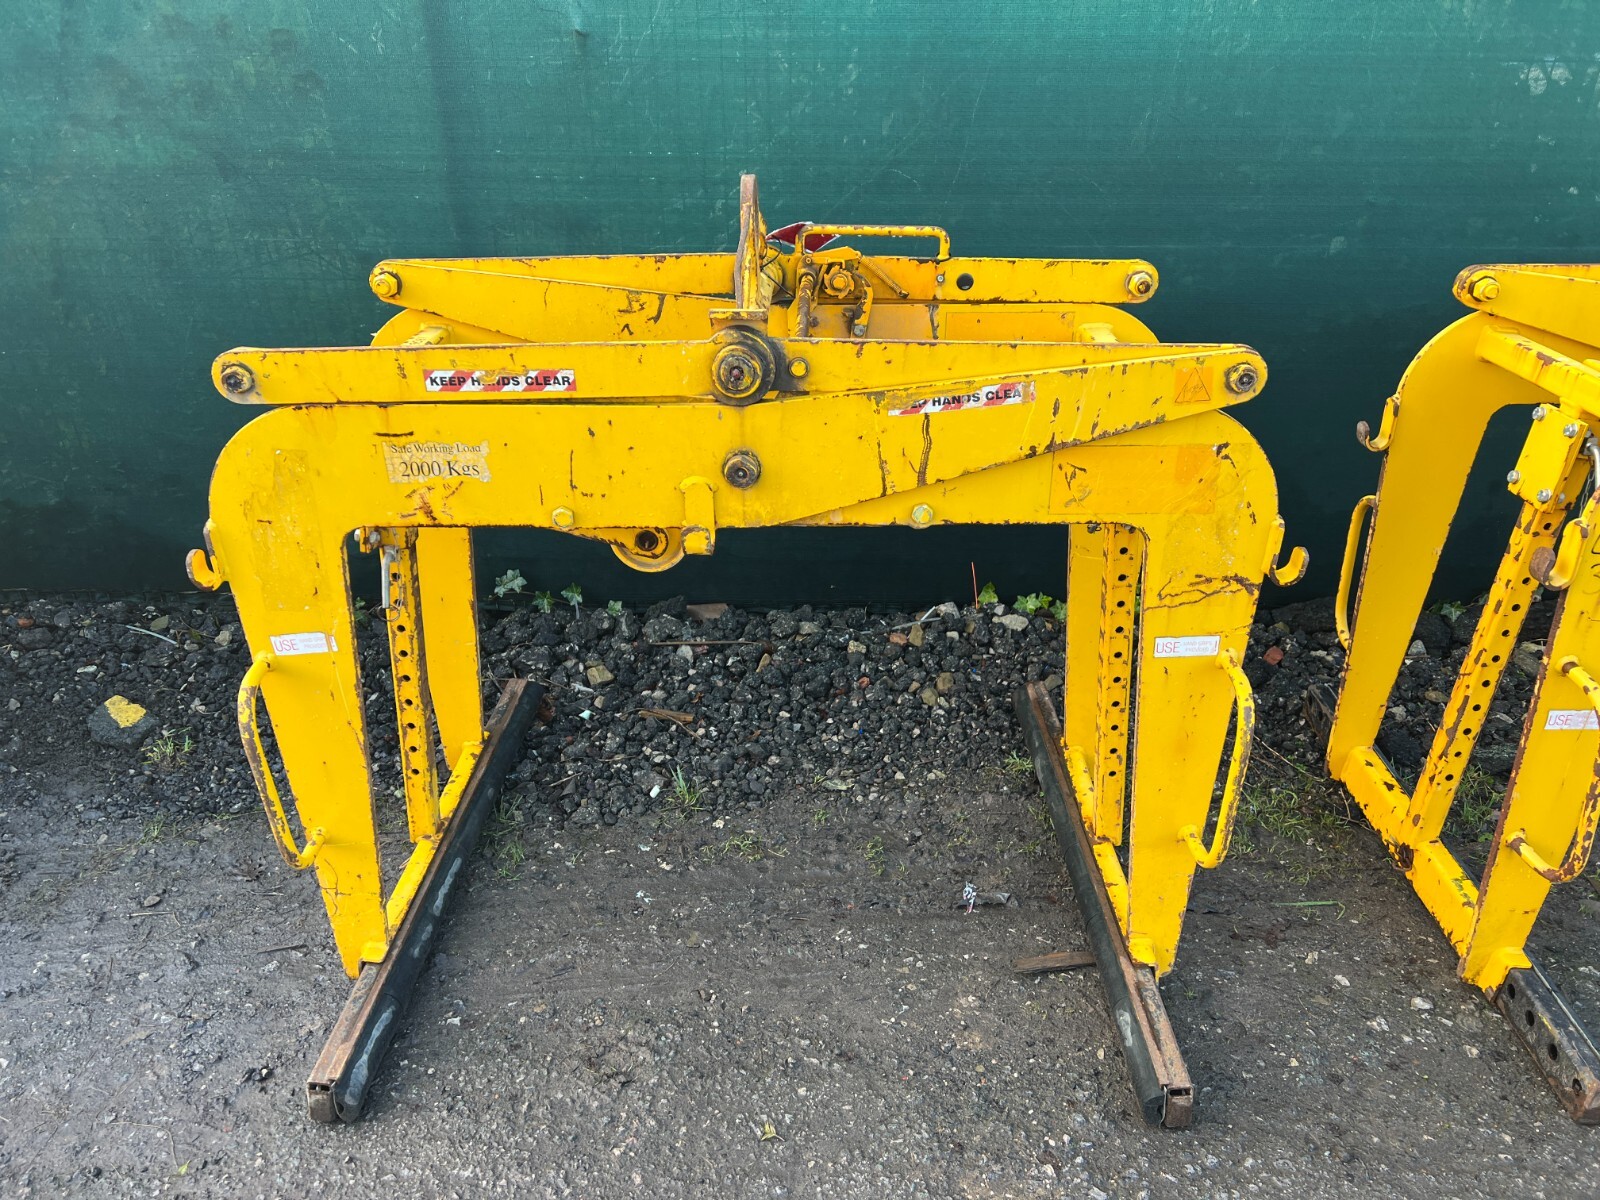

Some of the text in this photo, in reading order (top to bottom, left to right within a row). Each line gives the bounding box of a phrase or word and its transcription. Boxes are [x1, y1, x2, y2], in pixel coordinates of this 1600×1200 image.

[429, 376, 466, 386] KEEP
[525, 375, 571, 386] CLEAR
[932, 392, 981, 407] HANDS
[985, 388, 1022, 401] CLEA
[391, 443, 481, 455] Safe Working Load
[400, 460, 480, 477] 2000 Kgs
[273, 638, 300, 652] USE
[1156, 641, 1181, 654] USE
[1548, 714, 1574, 726] USE
